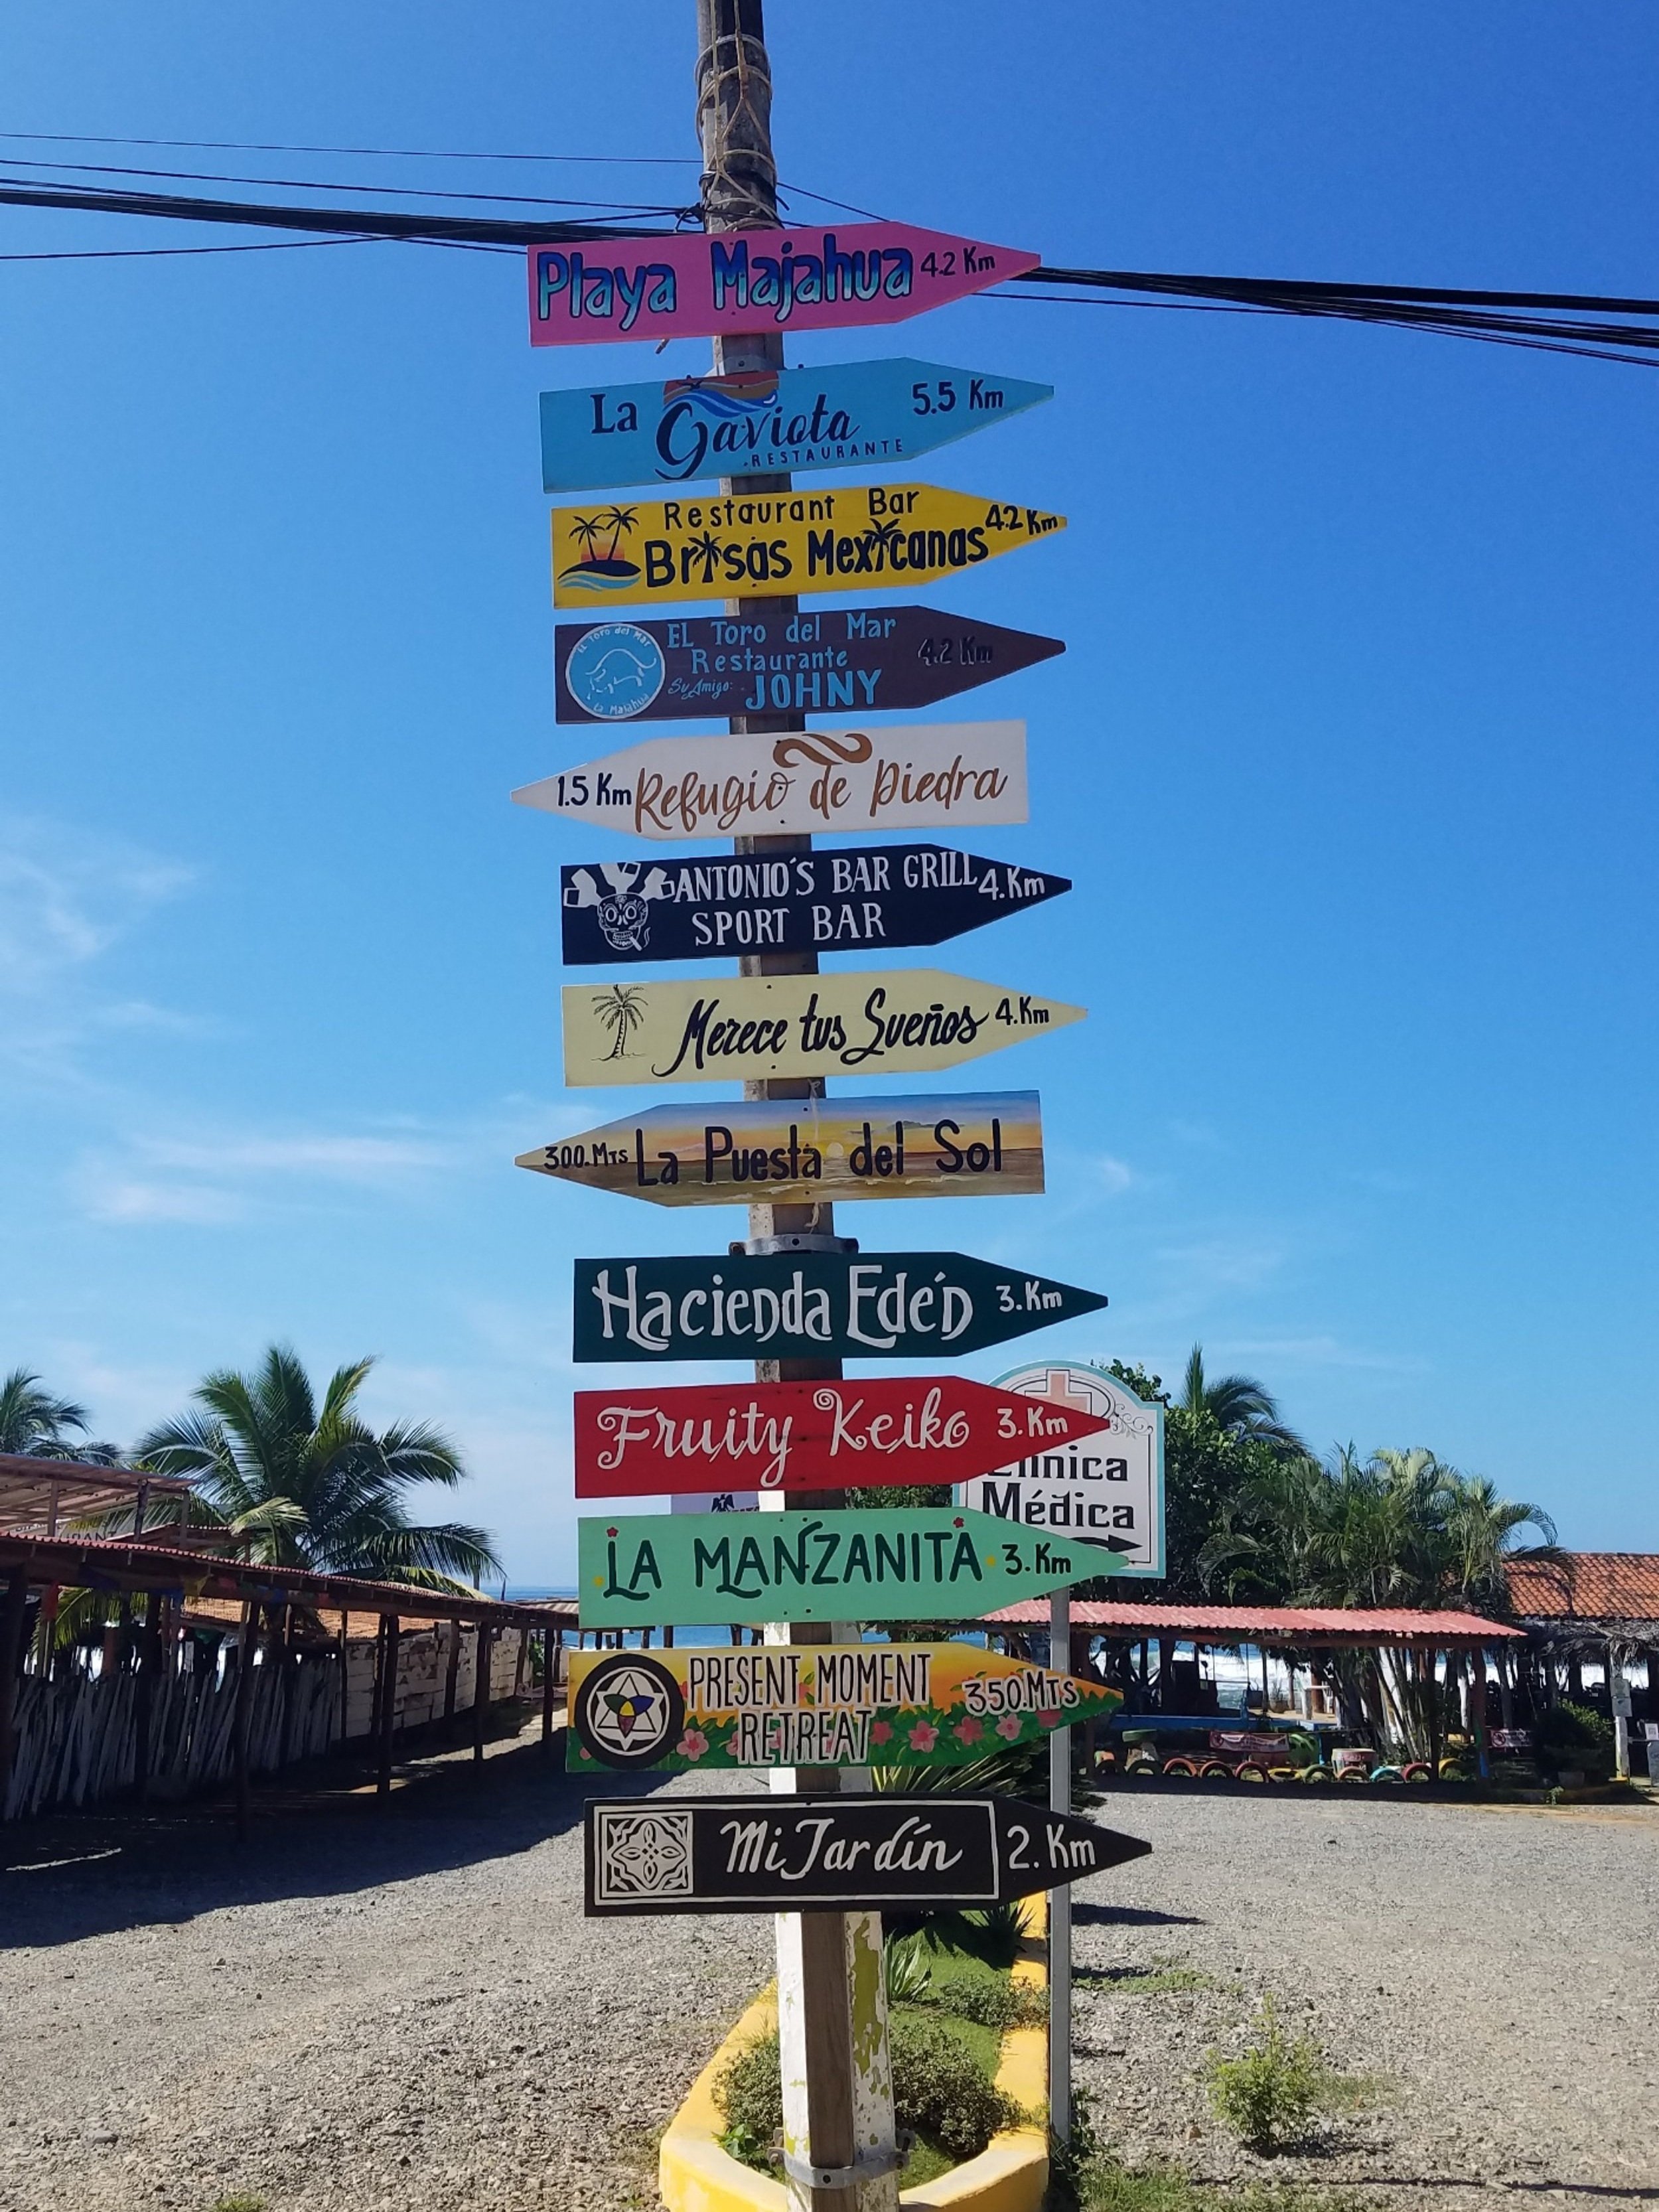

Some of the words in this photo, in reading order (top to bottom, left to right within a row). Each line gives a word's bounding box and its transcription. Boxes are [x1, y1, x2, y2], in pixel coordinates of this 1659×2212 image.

[537, 250, 677, 331] Playa
[710, 233, 914, 323] Majahua
[920, 251, 956, 279] 4.2
[964, 248, 996, 275] Km
[591, 392, 638, 435] La
[654, 393, 861, 480] Gaviota
[912, 382, 957, 416] 5.5
[969, 378, 1004, 409] Km
[751, 439, 904, 468] RESTAURANTE
[664, 494, 834, 531] Restaurant
[868, 488, 920, 518] Bar
[985, 504, 1024, 532] 4.2
[1027, 508, 1058, 536] Km
[614, 627, 631, 636] del
[632, 630, 652, 648] Mar
[667, 623, 695, 650] EL
[710, 619, 767, 646] Toro
[784, 615, 822, 643] del
[846, 612, 898, 641] Mar
[690, 646, 849, 676] Restaurante
[917, 638, 952, 666] 4.2
[959, 636, 993, 666] Km
[745, 669, 883, 711] JOHNY
[557, 774, 591, 807] 1.5
[596, 772, 632, 807] Km
[634, 766, 795, 833] Refugio
[808, 762, 853, 820] de
[831, 857, 892, 894] BAR
[902, 851, 979, 889] GRILL
[691, 908, 791, 947] SPORT
[812, 903, 887, 942] BAR
[651, 998, 788, 1078] Merece
[800, 993, 847, 1053] tus
[839, 987, 991, 1065] Sueños
[635, 1128, 680, 1187] La
[704, 1124, 822, 1183] Puesta
[849, 1120, 904, 1177] del
[934, 1117, 1002, 1173] Sol
[591, 1264, 833, 1351] Hacienda
[845, 1264, 974, 1349] Edén
[597, 1401, 794, 1488] Fruity
[812, 1386, 971, 1458] Keiko
[981, 1481, 1135, 1530] Médica
[603, 1538, 663, 1601] LA
[693, 1520, 984, 1599] MANZANITA
[688, 1653, 800, 1711] PRESENT
[816, 1652, 932, 1706] MOMENT
[737, 1708, 875, 1765] RETREAT
[720, 1820, 786, 1874] Mi
[780, 1816, 964, 1881] Jardín
